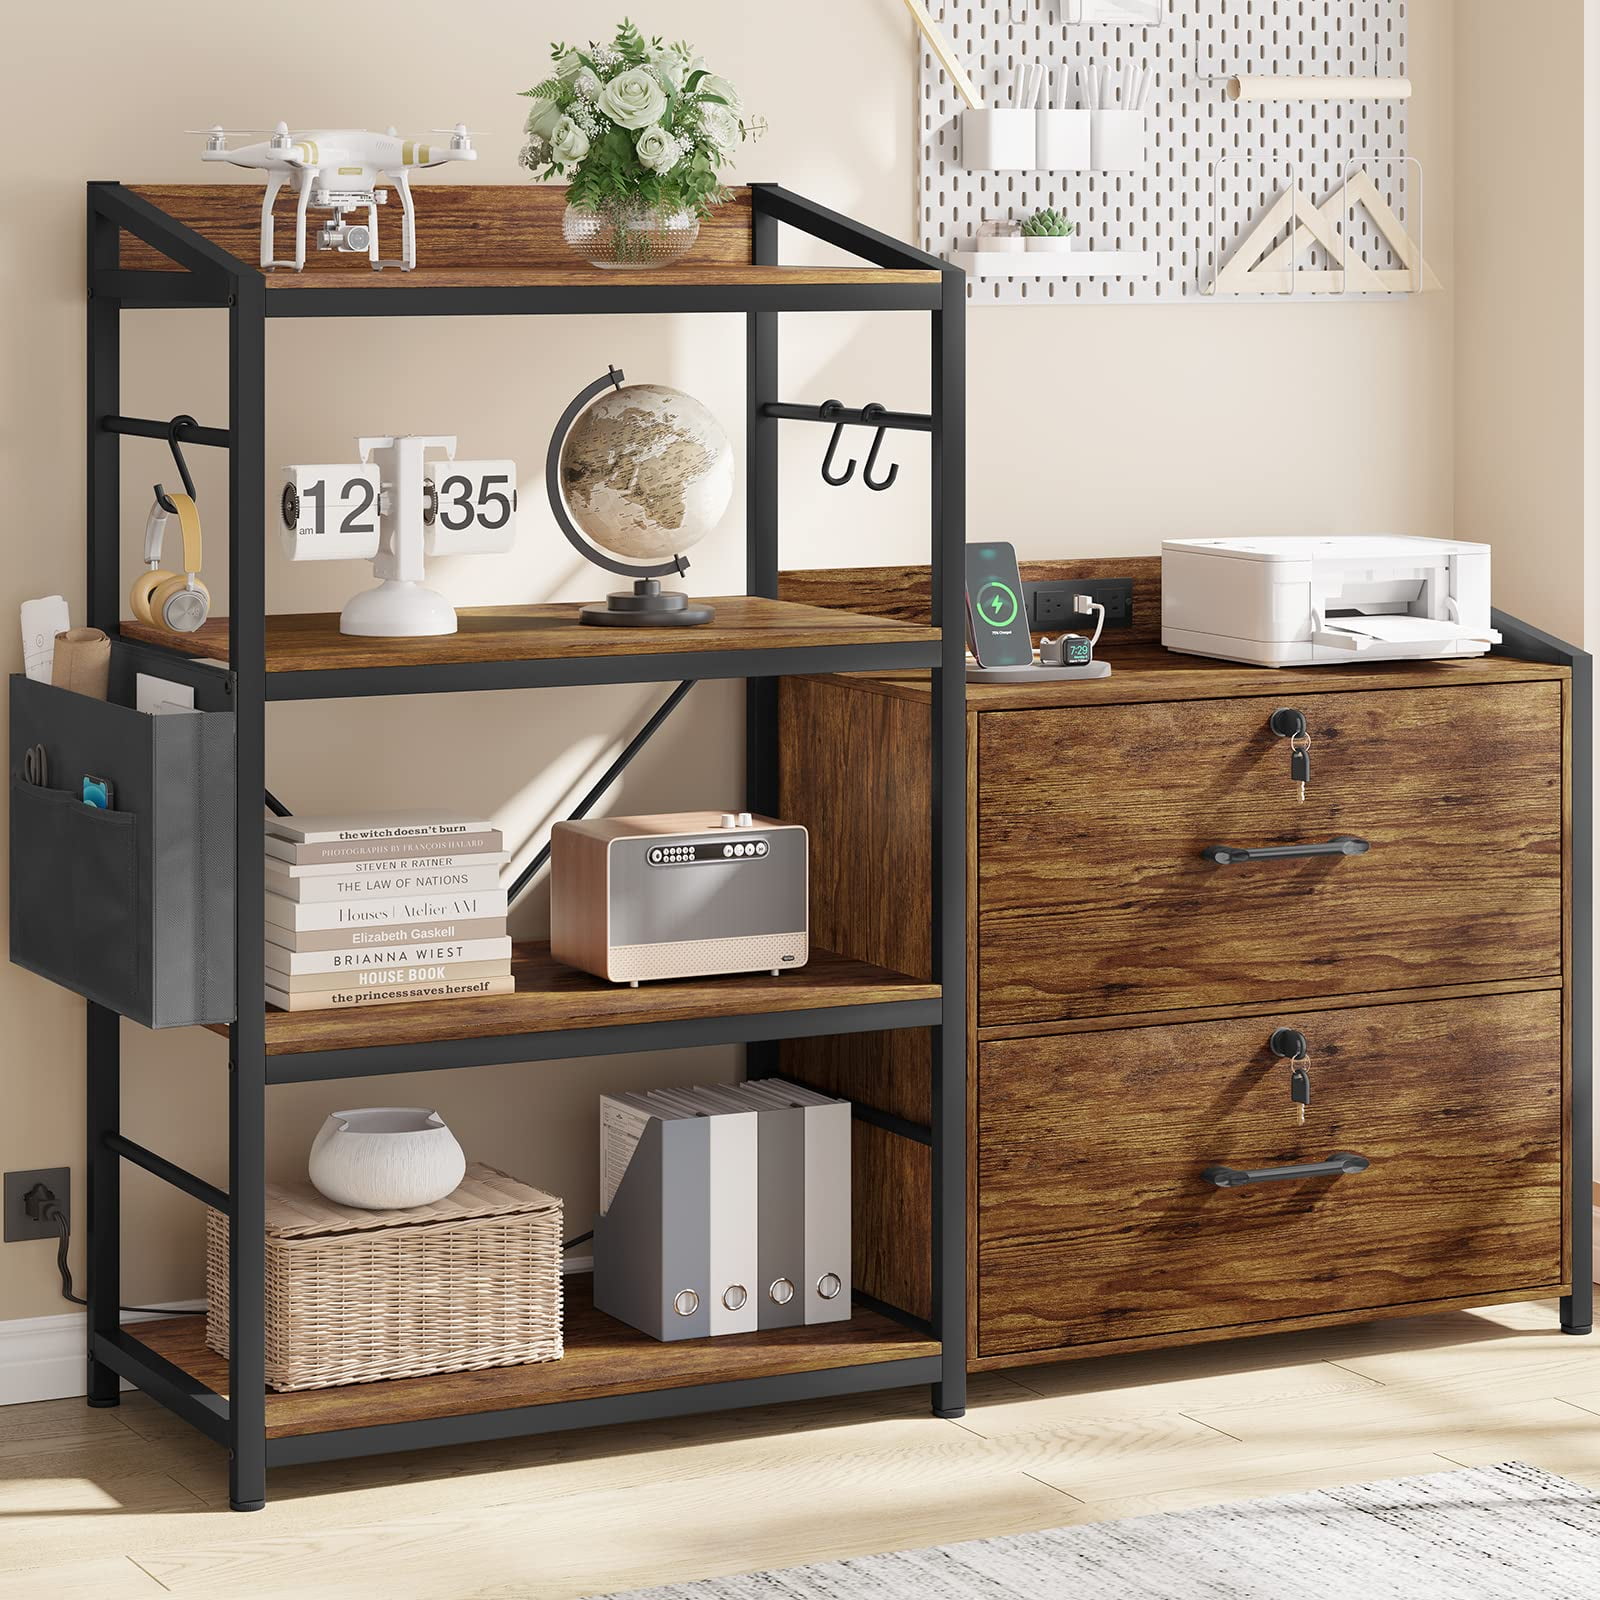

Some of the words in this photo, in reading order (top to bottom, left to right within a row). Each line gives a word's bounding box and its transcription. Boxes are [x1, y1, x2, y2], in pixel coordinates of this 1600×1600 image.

[302, 477, 375, 535] 12
[440, 474, 511, 531] 35
[299, 526, 314, 535] am
[1070, 645, 1088, 655] 7:29
[339, 831, 359, 840] the
[360, 829, 393, 839] witch
[393, 826, 438, 836] doesn't
[439, 825, 467, 834] burn
[321, 845, 389, 857] PHOTOGRAPHS
[390, 844, 401, 854] BY
[448, 839, 484, 849] HALARD
[355, 861, 397, 872] STEVEN
[400, 860, 408, 869] R
[411, 857, 453, 868] RATNER
[337, 881, 361, 893] THE
[366, 879, 391, 891] LAW
[395, 878, 411, 889] OF
[416, 874, 469, 887] NATIONS
[339, 908, 388, 922] Houses
[352, 929, 408, 944] Elizabeth
[410, 925, 455, 940] Gaskell
[333, 951, 408, 967] BRIANNA
[416, 946, 463, 960] WIEST
[359, 969, 405, 985] HOUSE
[408, 966, 446, 981] BOOK
[331, 993, 353, 1003] the
[354, 989, 409, 1004] princess
[409, 986, 445, 997] saves
[445, 981, 491, 995] herself
